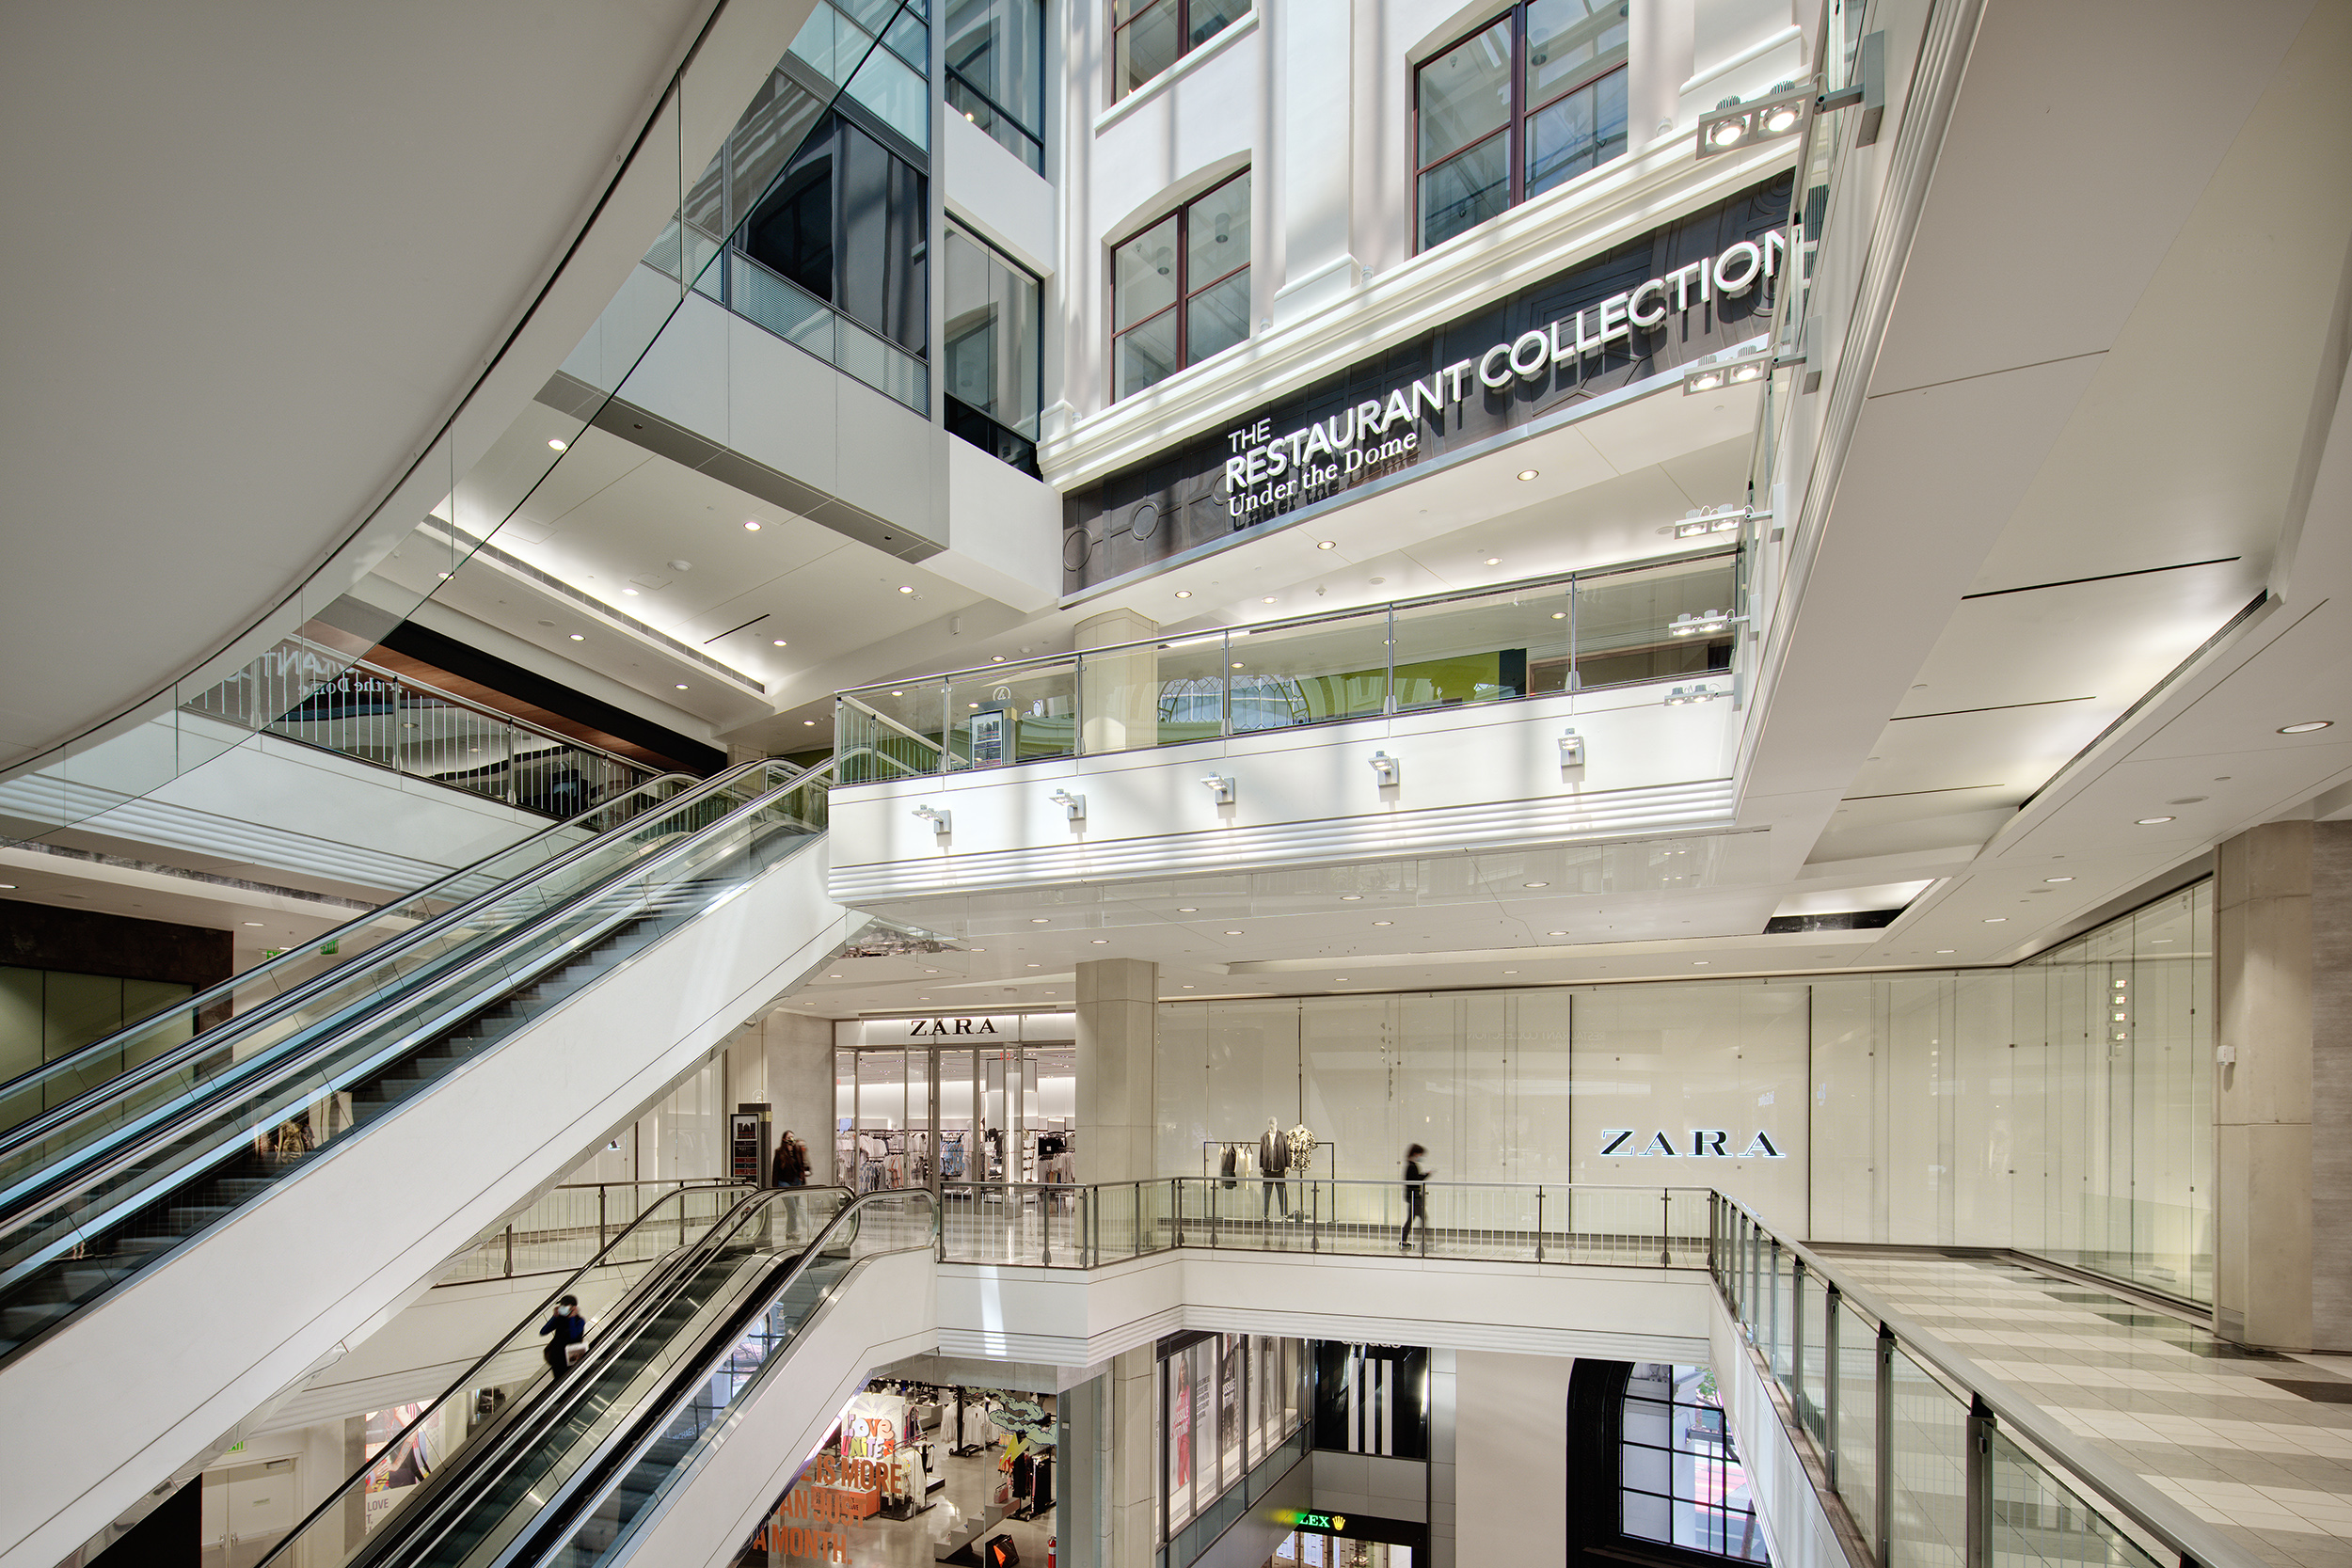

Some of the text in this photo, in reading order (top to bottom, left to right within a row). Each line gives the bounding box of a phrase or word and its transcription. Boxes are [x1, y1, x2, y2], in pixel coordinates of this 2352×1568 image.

[1226, 358, 1471, 493] RESTAURANT
[1228, 417, 1271, 453] THE
[1228, 432, 1418, 517] Under the Dome
[910, 1018, 999, 1036] ZARA
[1600, 1130, 1786, 1158] ZARA
[817, 1454, 836, 1485] IS
[841, 1457, 902, 1494] MORE
[367, 1498, 389, 1512] LOVE
[813, 1493, 864, 1528] JUST
[753, 1524, 852, 1565] A MONTH.
